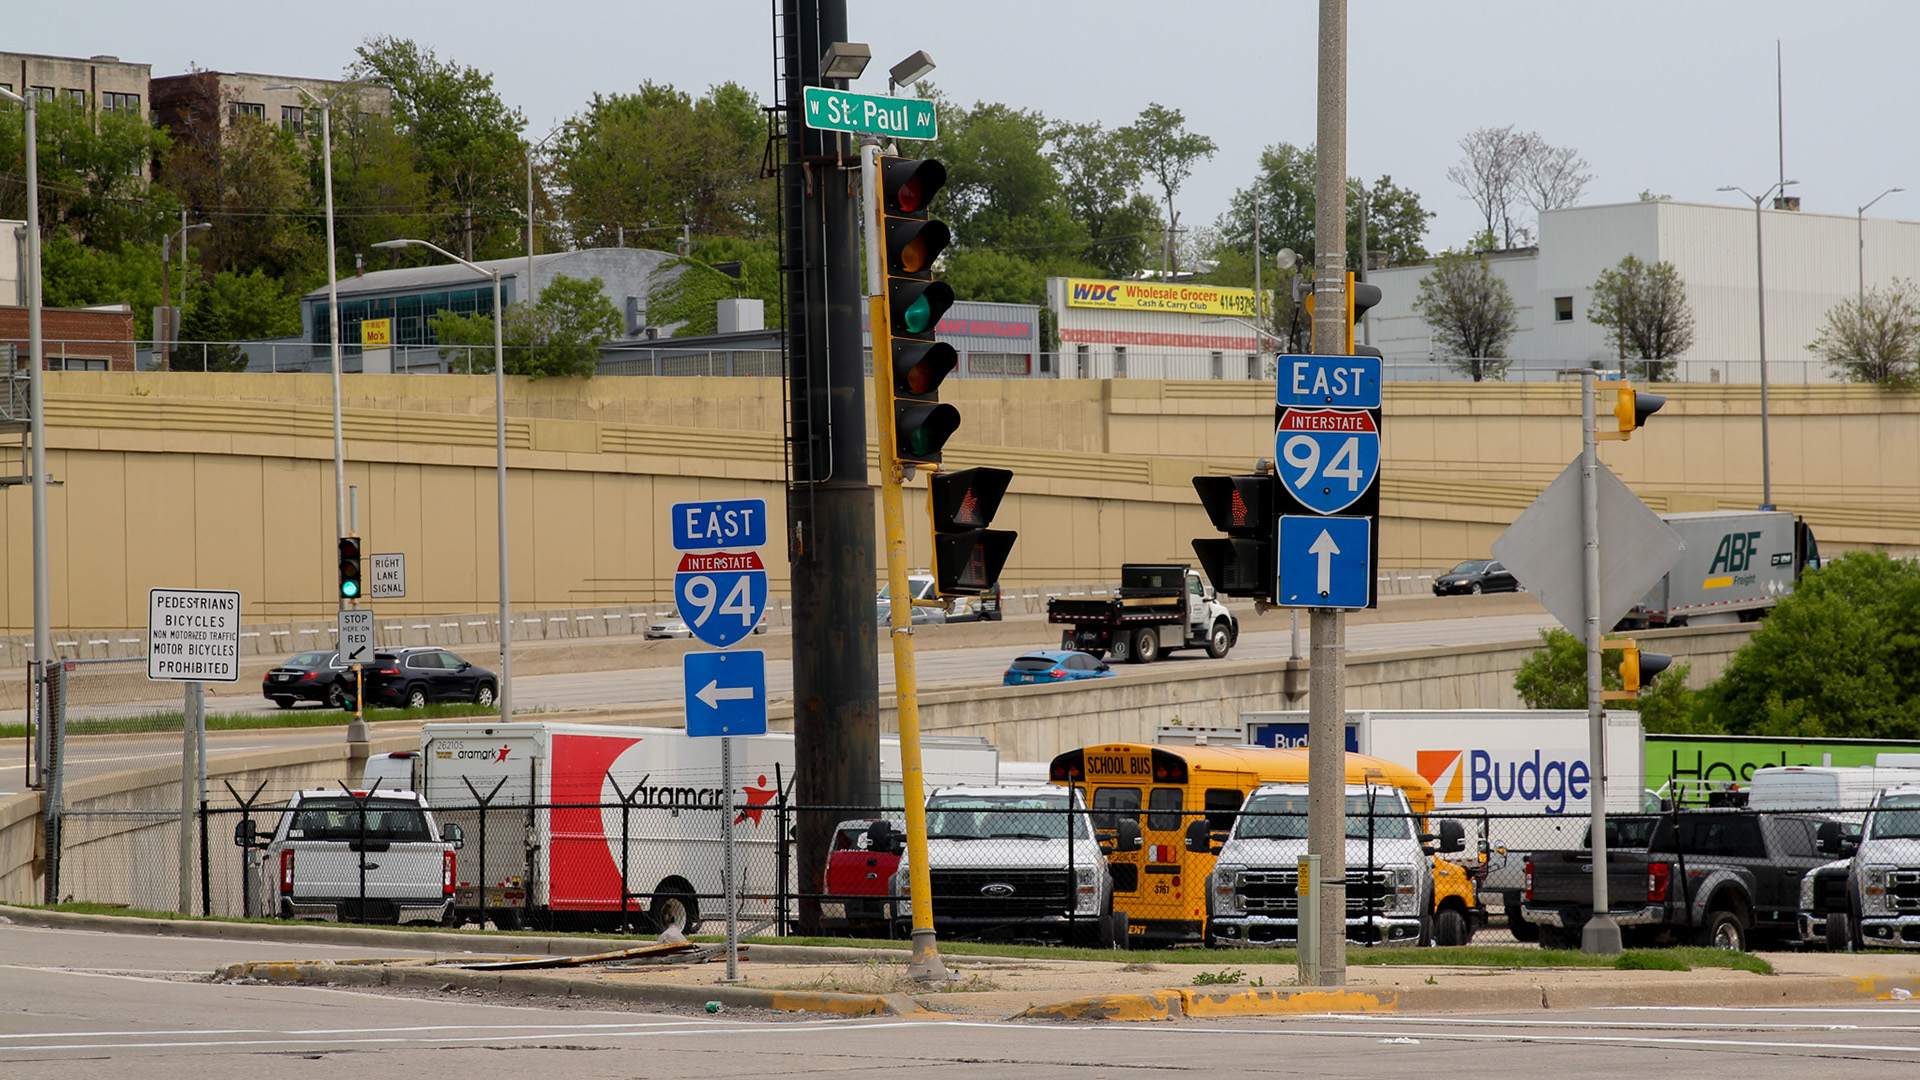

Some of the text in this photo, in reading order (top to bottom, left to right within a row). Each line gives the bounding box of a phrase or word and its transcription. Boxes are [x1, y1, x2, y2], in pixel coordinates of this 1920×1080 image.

[810, 96, 931, 131] W St. Paul AV
[1073, 283, 1120, 302] WDC
[1126, 285, 1218, 302] Wholesale Grocers
[1137, 299, 1157, 307] Cash
[1158, 299, 1165, 308] &
[1166, 300, 1188, 311] Carry
[1189, 301, 1208, 310] Club
[367, 331, 385, 341] Mo's
[970, 321, 1029, 337] DISTILLERY
[1292, 361, 1366, 396] EAST
[1291, 416, 1364, 430] INTERSTATE
[1283, 434, 1363, 492] 94
[686, 507, 754, 539] EAST
[1708, 530, 1762, 575] ABF
[375, 558, 400, 568] RIGHT
[688, 556, 753, 570] INTERSTATE
[377, 571, 399, 581] LANE
[1732, 574, 1756, 587] Freight
[373, 584, 403, 593] SIGNAL
[157, 596, 234, 610] PEDESTRIANS
[684, 575, 756, 628] 94
[165, 614, 225, 628] BICYCLES
[344, 614, 368, 624] STOP
[153, 629, 236, 641] NON MOTORIZED TRAFFIC
[347, 634, 367, 643] RED
[153, 643, 234, 657] MOTOR BICYCLES
[159, 660, 229, 674] PROHIBITED
[437, 741, 464, 750] 26210S
[1274, 733, 1309, 749] Bud
[457, 748, 497, 760] aramark
[1087, 756, 1151, 775] SCHOOL BUS
[1470, 749, 1590, 815] Budge
[633, 785, 737, 811] aramar
[1127, 925, 1147, 935] ENT
